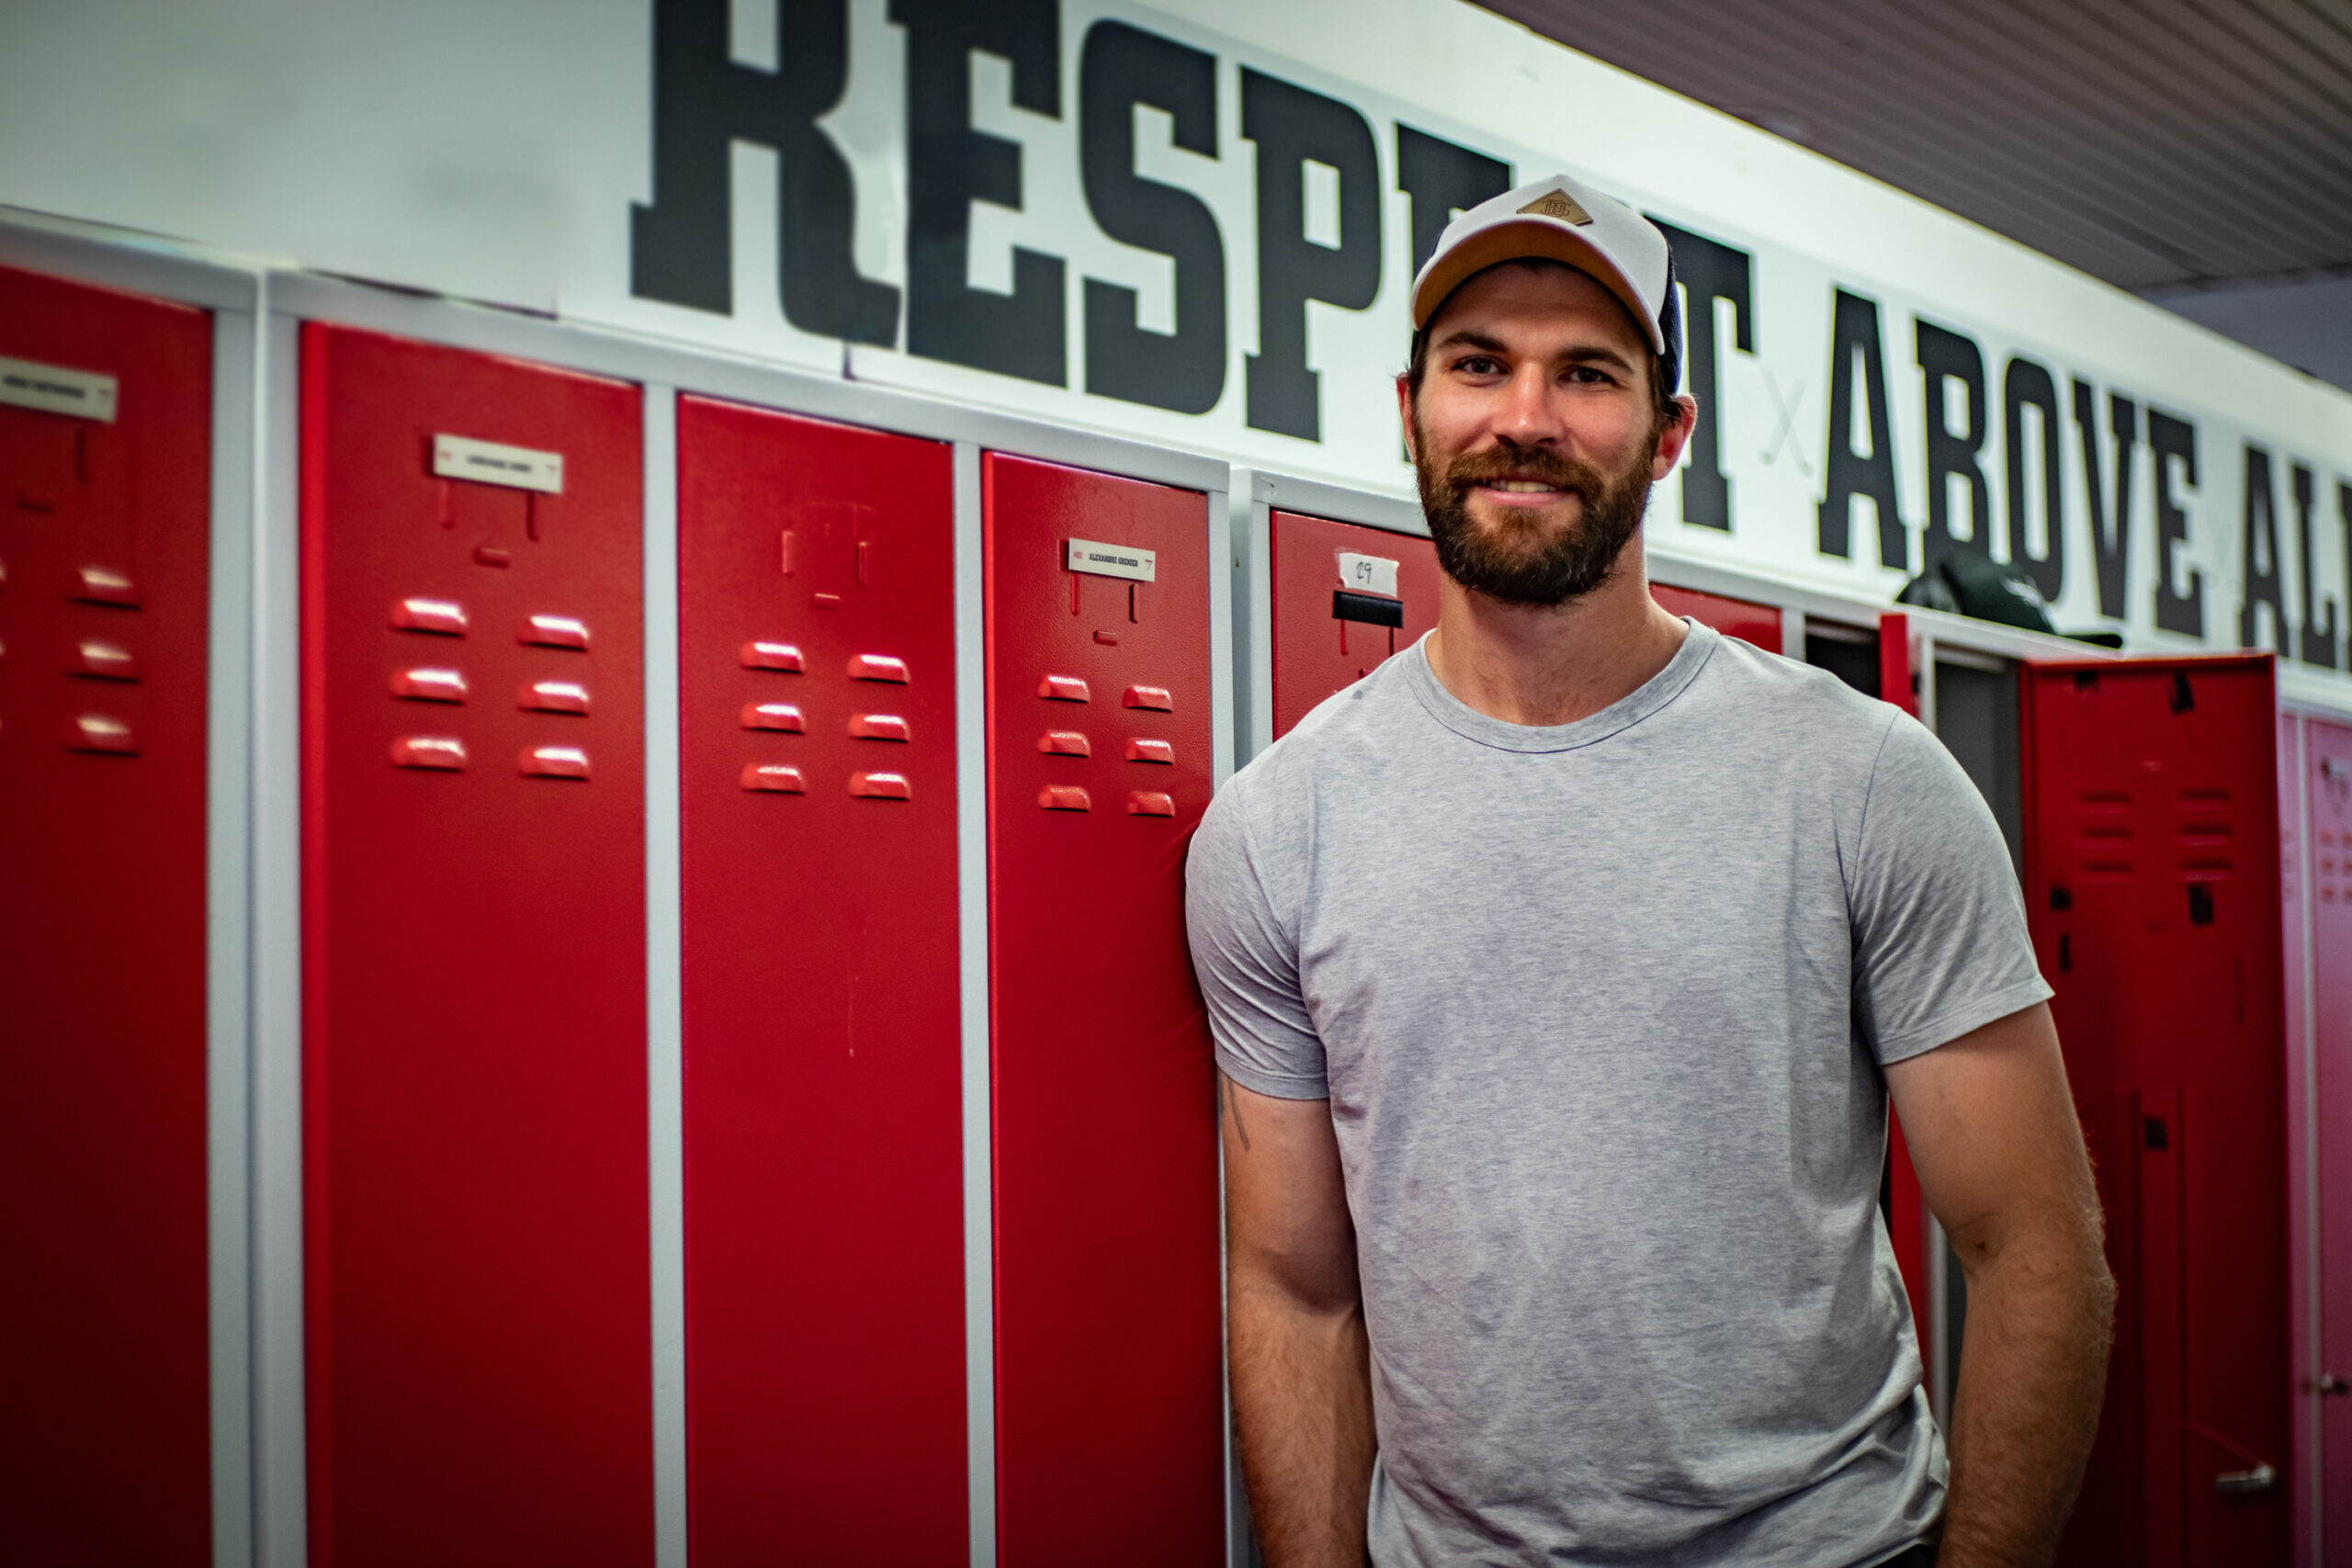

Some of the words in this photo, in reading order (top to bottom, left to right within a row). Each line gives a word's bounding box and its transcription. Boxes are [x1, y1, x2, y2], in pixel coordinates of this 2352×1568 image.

[629, 0, 1754, 533] RESPT
[1817, 285, 2203, 639] ABOVE
[1089, 552, 1117, 564] ALEXANDRE
[1356, 561, 1372, 584] 29
